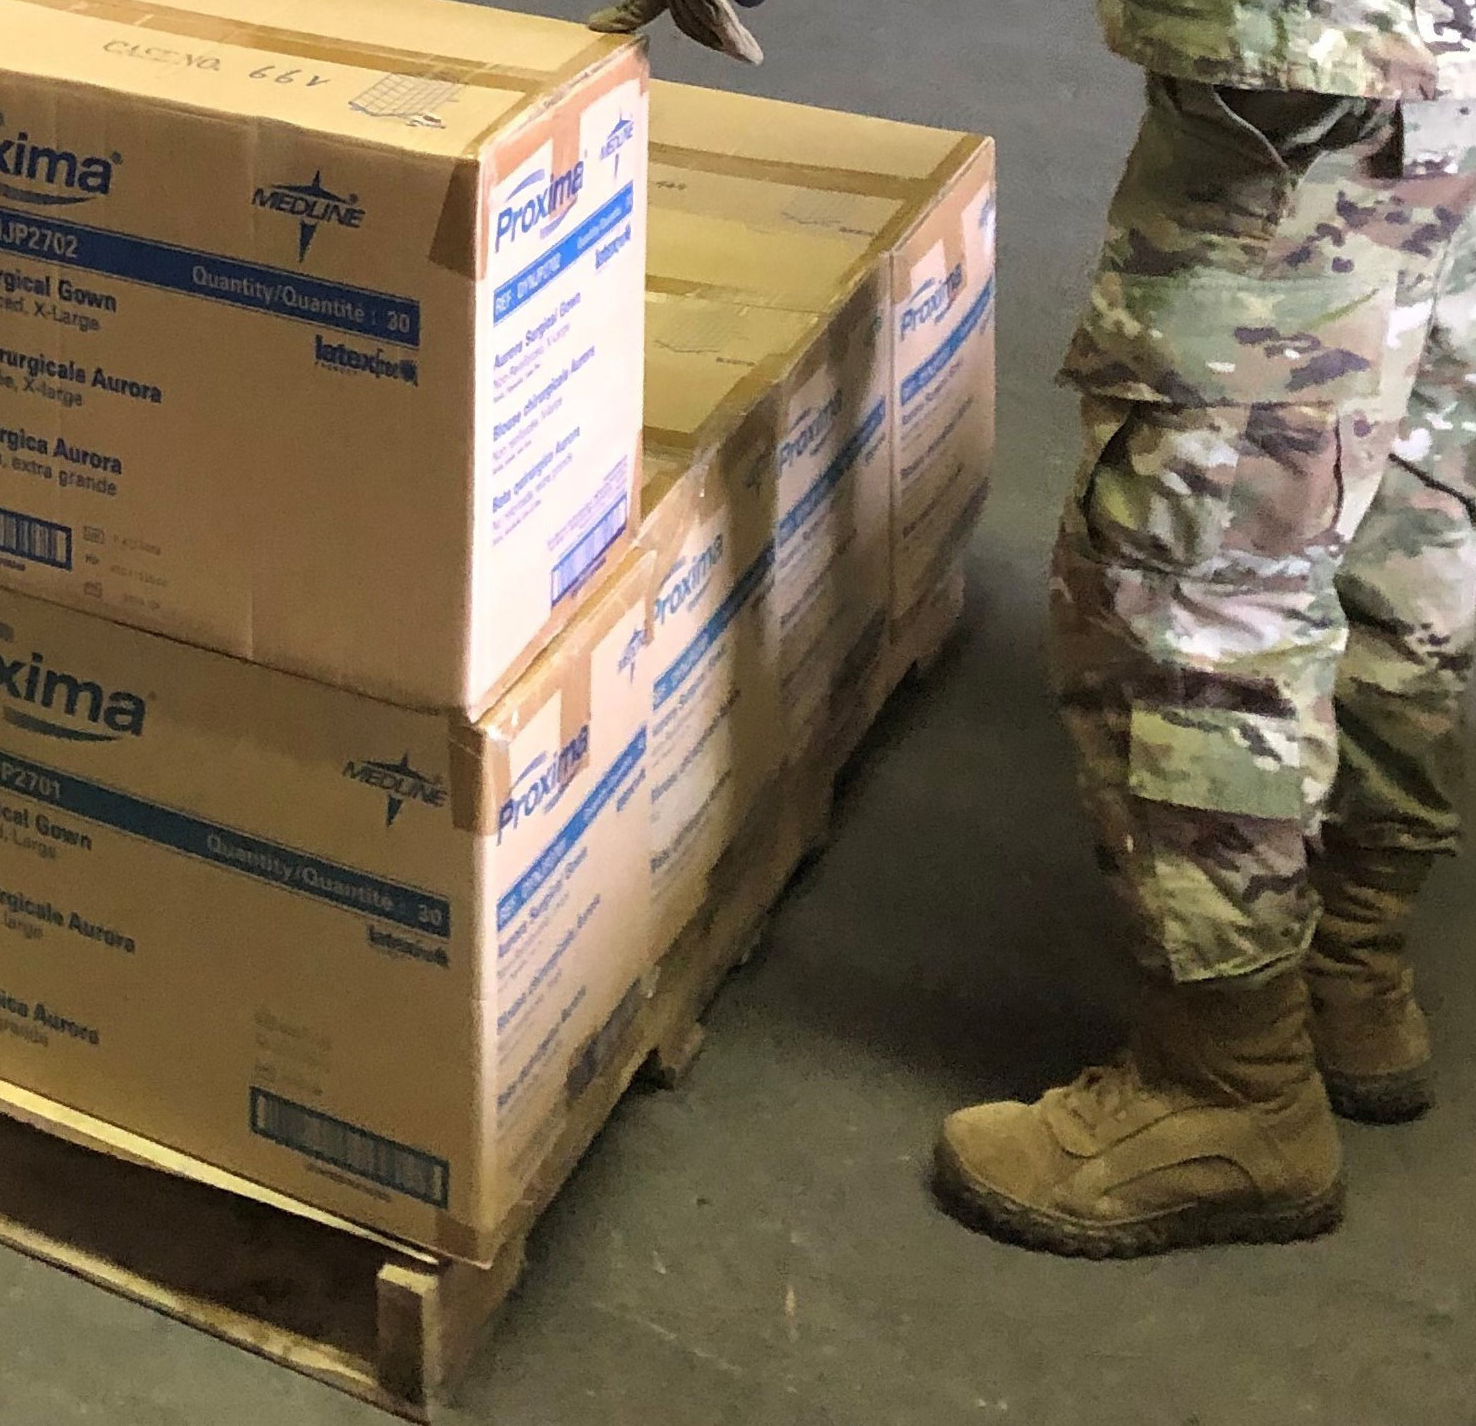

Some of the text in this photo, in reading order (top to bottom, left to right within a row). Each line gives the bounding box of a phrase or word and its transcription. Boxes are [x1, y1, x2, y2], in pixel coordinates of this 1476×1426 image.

[251, 184, 365, 232] MEDLINE
[495, 153, 584, 253] Proxima
[57, 279, 117, 314] Gown
[33, 299, 101, 335] X-Large
[386, 308, 410, 335] 30
[91, 366, 162, 406] Aurora
[53, 436, 122, 476] Aurora
[58, 465, 117, 500] grande
[341, 757, 448, 811] MEDLINE
[497, 725, 589, 846] Proxima
[35, 811, 92, 852] Gown
[67, 908, 136, 956] Aurora
[417, 901, 443, 929] 30
[33, 1000, 99, 1048] Aurora
